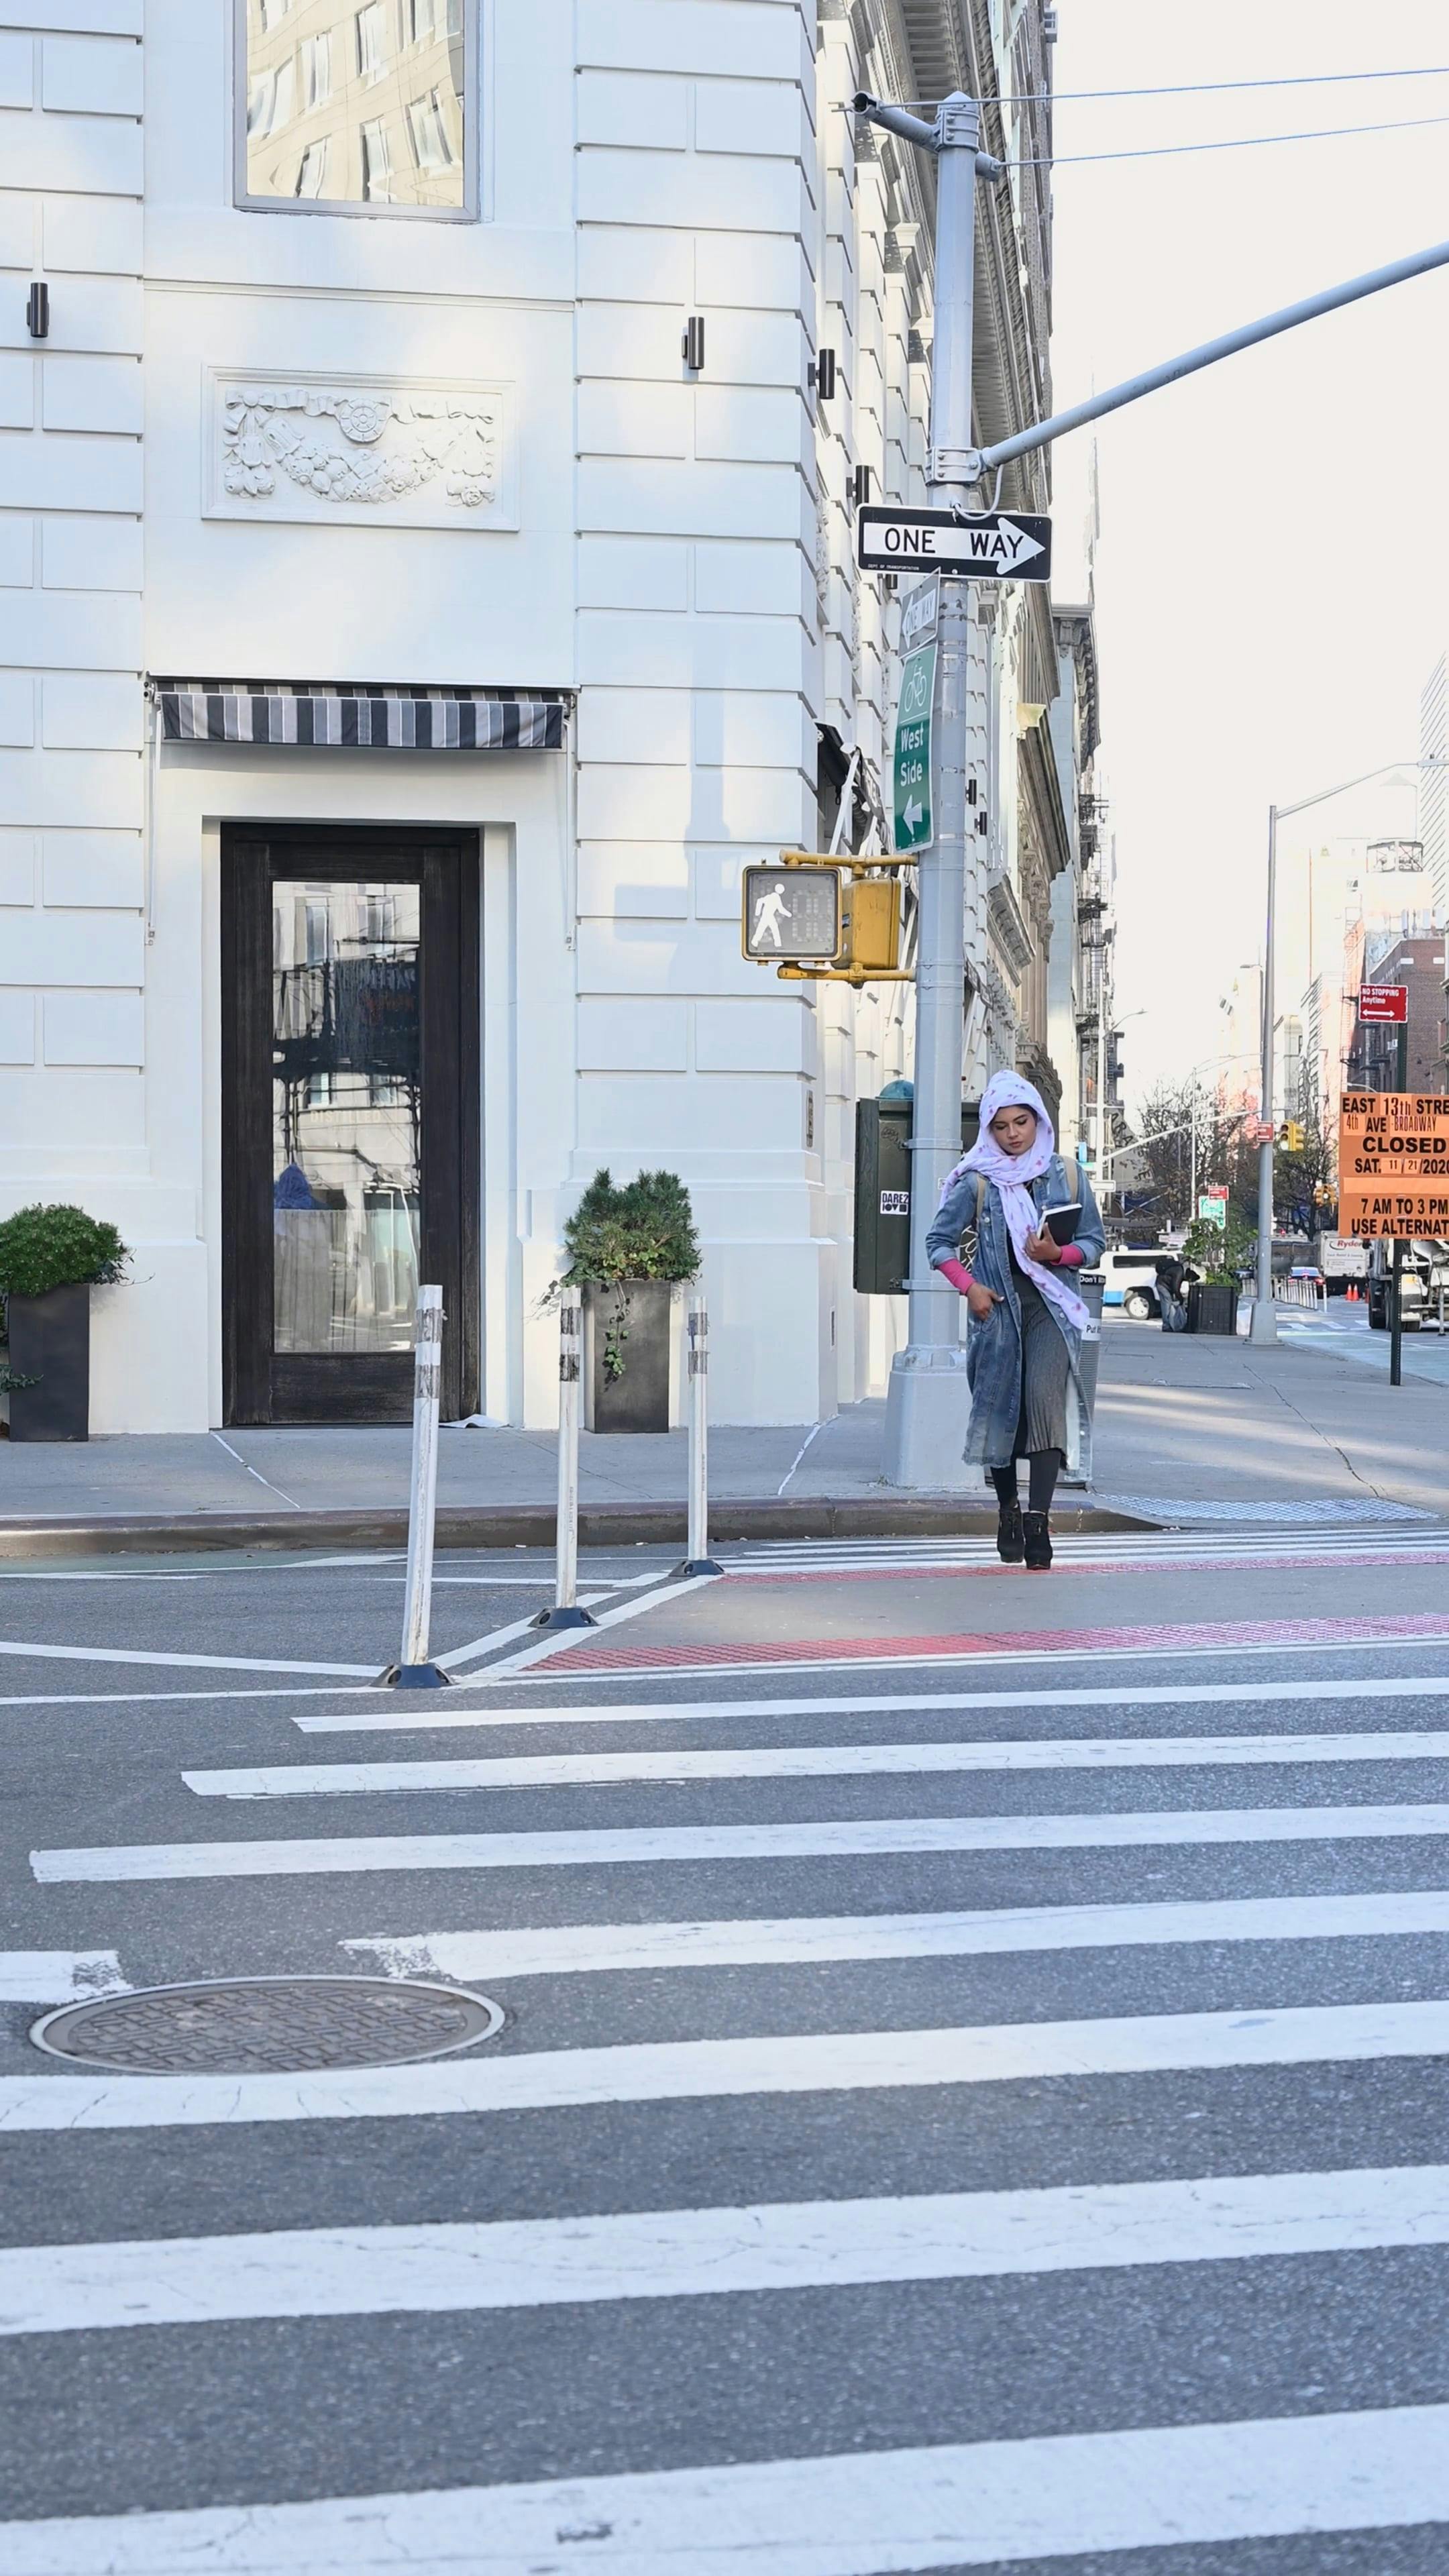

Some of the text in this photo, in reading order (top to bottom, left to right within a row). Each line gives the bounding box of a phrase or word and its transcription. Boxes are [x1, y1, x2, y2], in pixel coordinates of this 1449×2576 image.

[885, 528, 1024, 559] ONE WAY
[901, 722, 924, 753] West
[900, 759, 923, 787] Side
[1362, 996, 1386, 1005] Anytime
[1371, 988, 1399, 997] STOPPING
[1342, 1097, 1375, 1113] EAST
[1383, 1097, 1411, 1116] 13th
[1346, 1114, 1358, 1130] 4th
[1366, 1117, 1387, 1132] AVE
[1362, 1136, 1446, 1153] CLOSED
[1354, 1158, 1381, 1173] SAT.
[882, 1193, 909, 1203] DARE2
[1361, 1198, 1448, 1215] 7 AM TO 3 PM
[1351, 1218, 1377, 1234] USE
